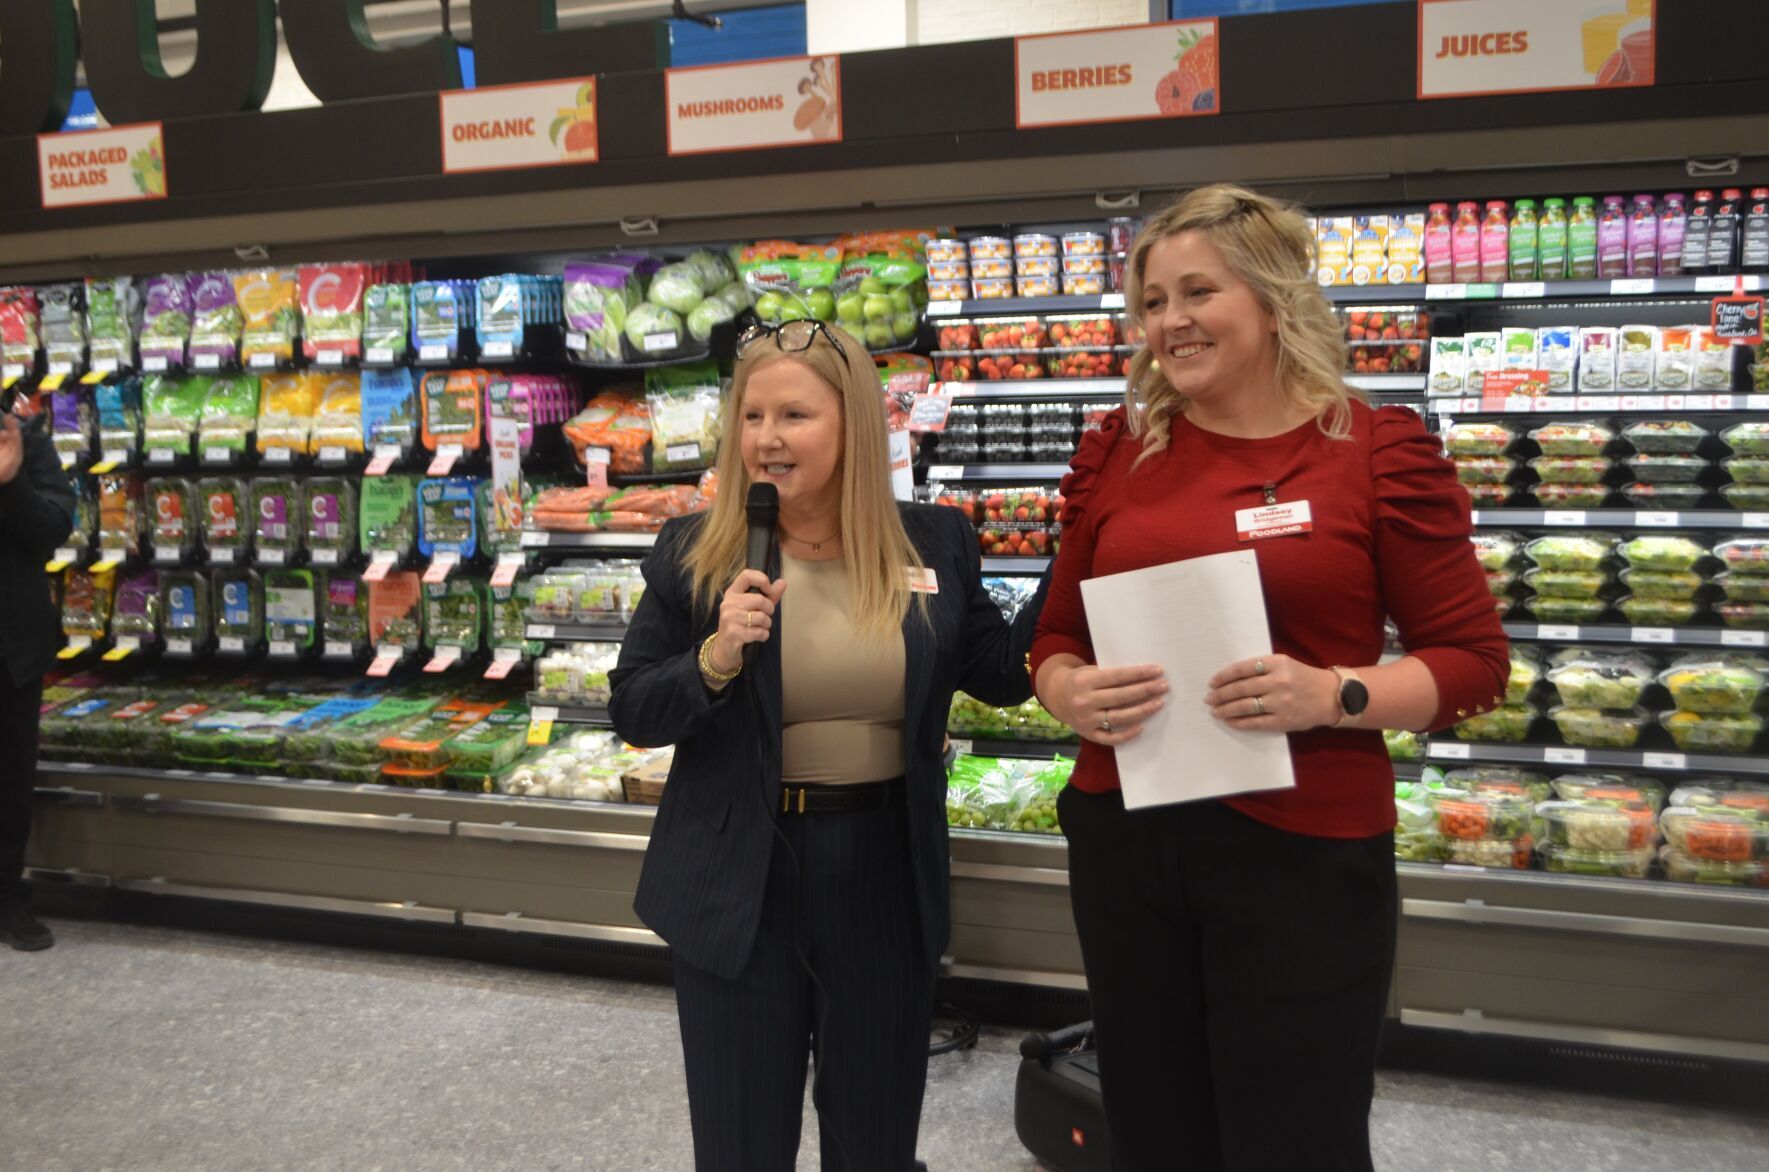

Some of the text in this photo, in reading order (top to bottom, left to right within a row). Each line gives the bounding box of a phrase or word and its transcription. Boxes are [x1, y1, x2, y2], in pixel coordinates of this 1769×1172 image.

[1436, 31, 1529, 60] JUICES
[1031, 63, 1133, 93] BERRIES
[677, 95, 785, 119] MUSHROOMS
[452, 117, 536, 142] ORGANIC
[47, 146, 128, 170] PACKAGED
[49, 167, 109, 190] SALADS
[1249, 525, 1302, 538] FOODLAND
